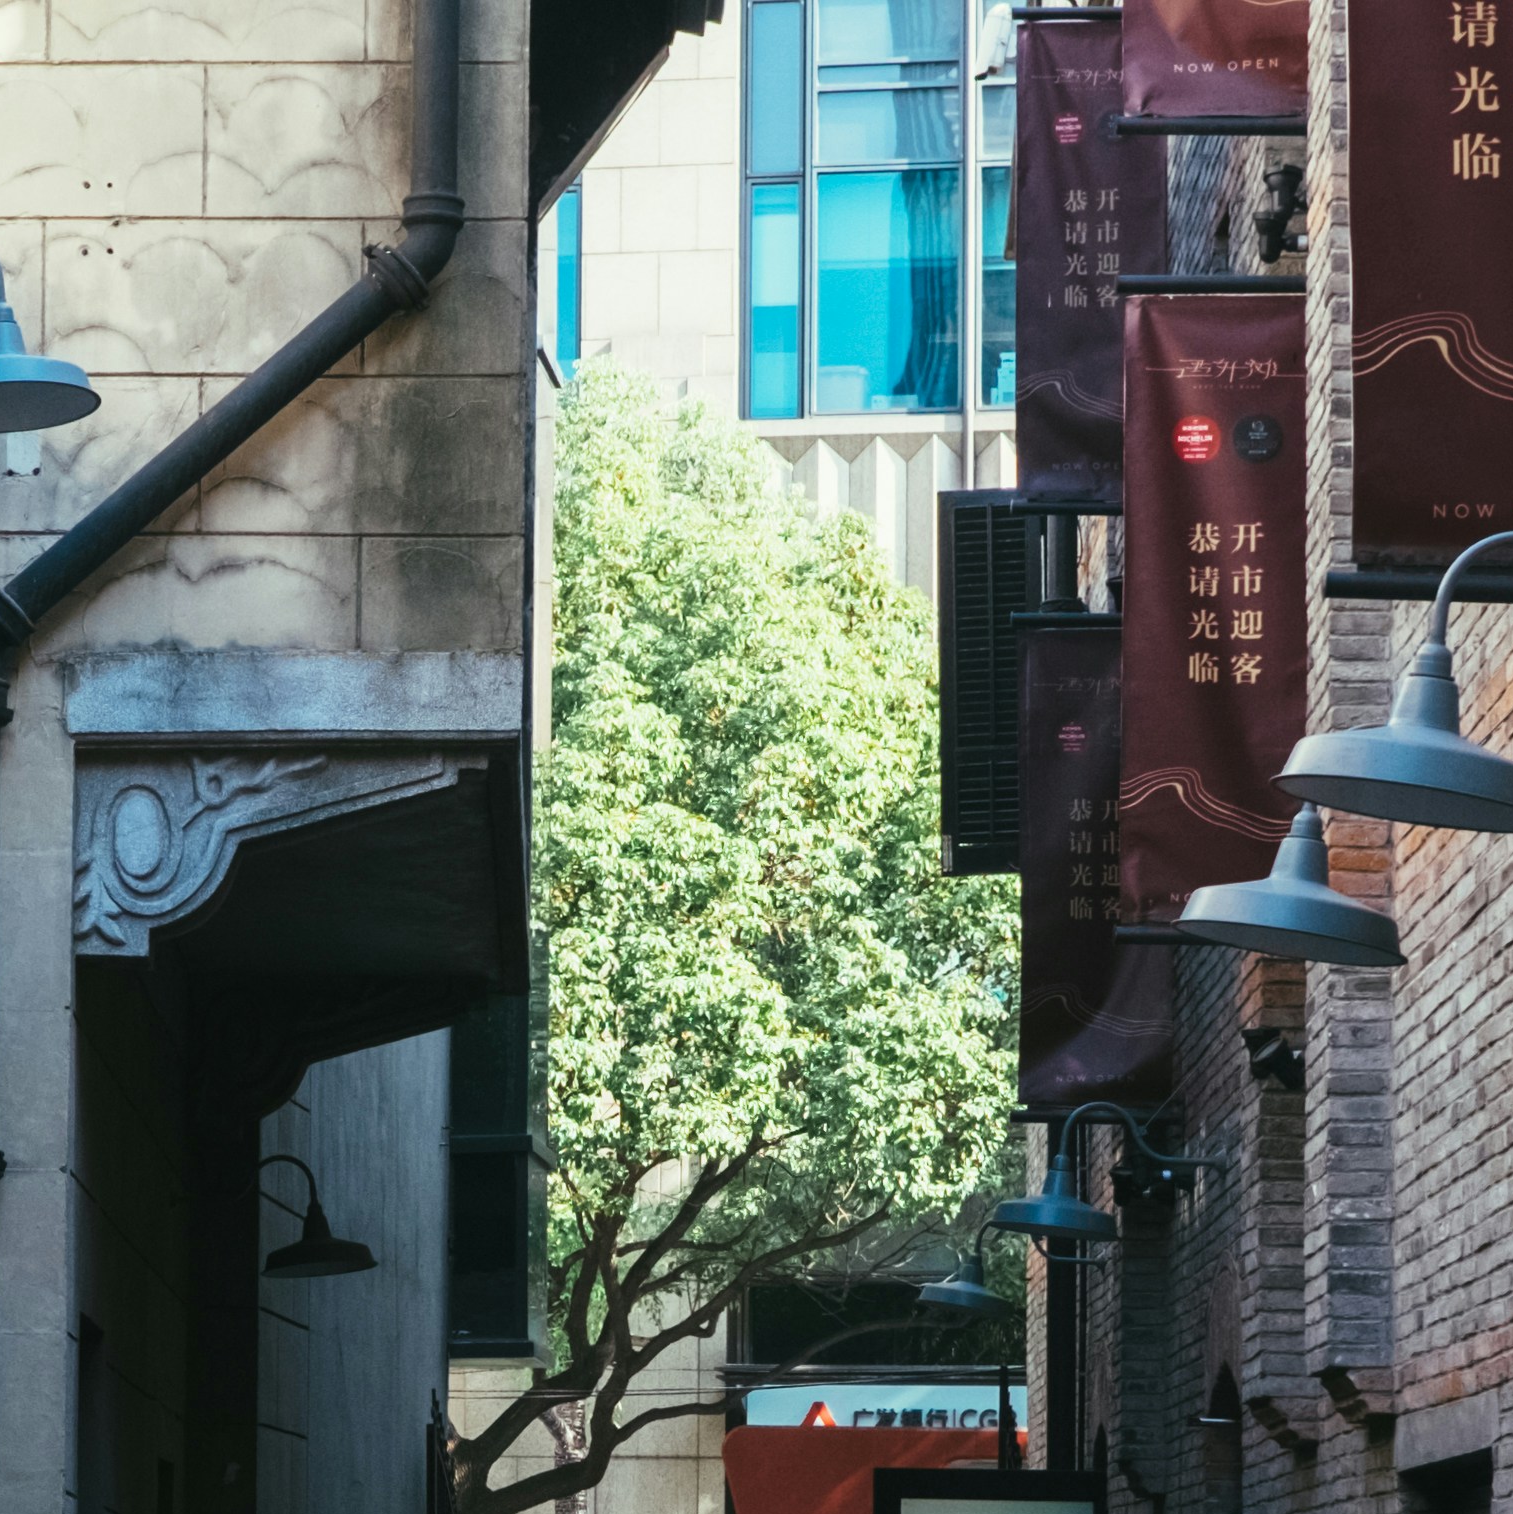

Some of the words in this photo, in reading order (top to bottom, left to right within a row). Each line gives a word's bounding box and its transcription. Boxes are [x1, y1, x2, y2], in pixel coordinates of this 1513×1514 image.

[1173, 62, 1214, 73] NOW
[1227, 58, 1279, 71] OPEN
[1063, 188, 1088, 308] 恭请光临
[1095, 188, 1121, 308] 开市迎客
[1051, 462, 1082, 471] NOW
[1433, 503, 1495, 519] NOW
[1187, 522, 1221, 684] 恭请光临
[1230, 521, 1265, 685] 开市迎客
[1069, 798, 1093, 920] 恭请光临
[1055, 1074, 1087, 1083] NOW
